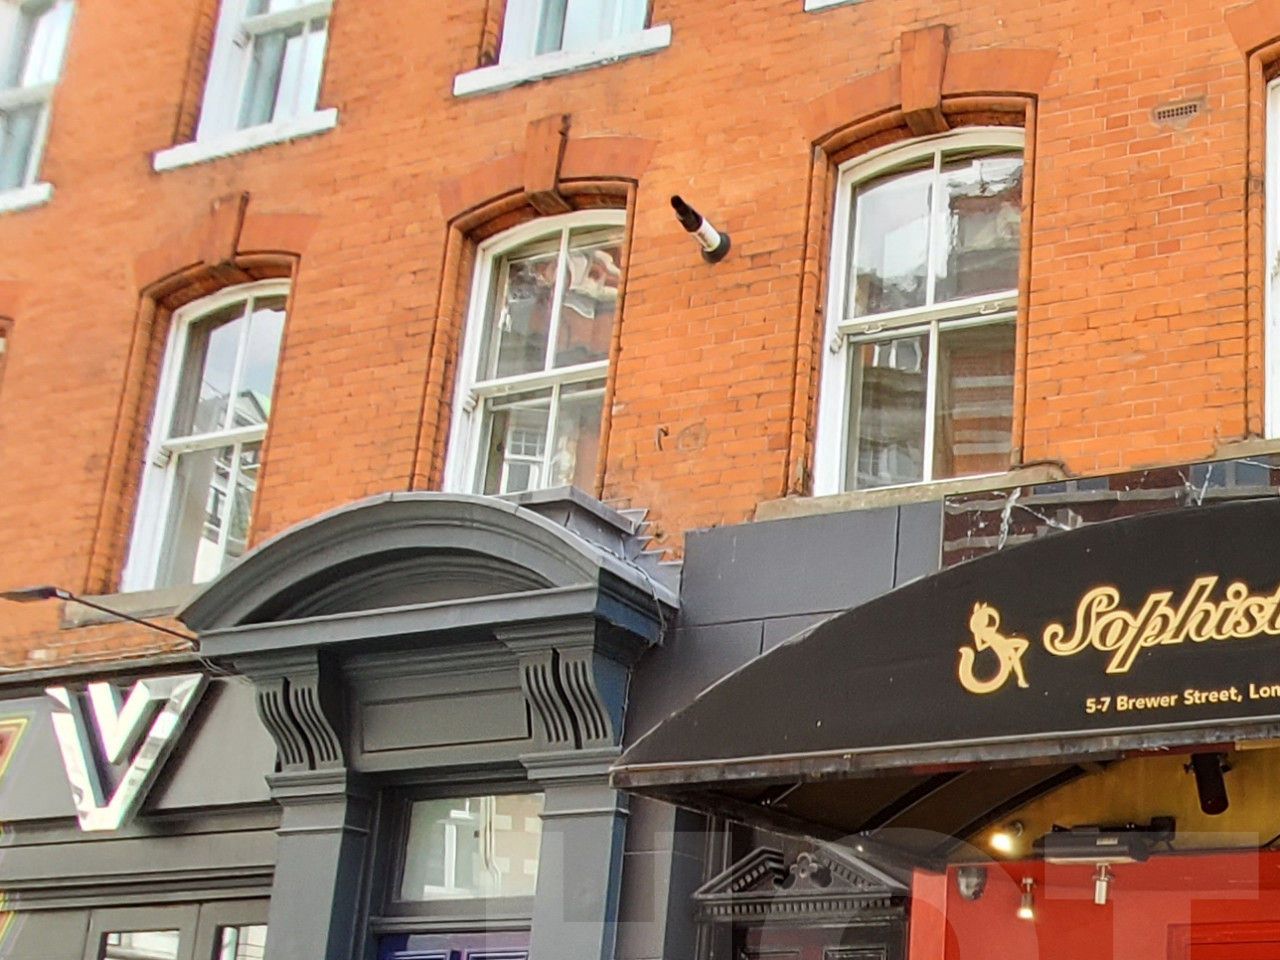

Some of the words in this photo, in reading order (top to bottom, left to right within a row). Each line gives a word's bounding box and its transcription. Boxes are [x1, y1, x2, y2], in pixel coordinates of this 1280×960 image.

[1085, 697, 1112, 714] 5-7
[1116, 693, 1178, 711] Brewer
[1183, 686, 1243, 705] Street,
